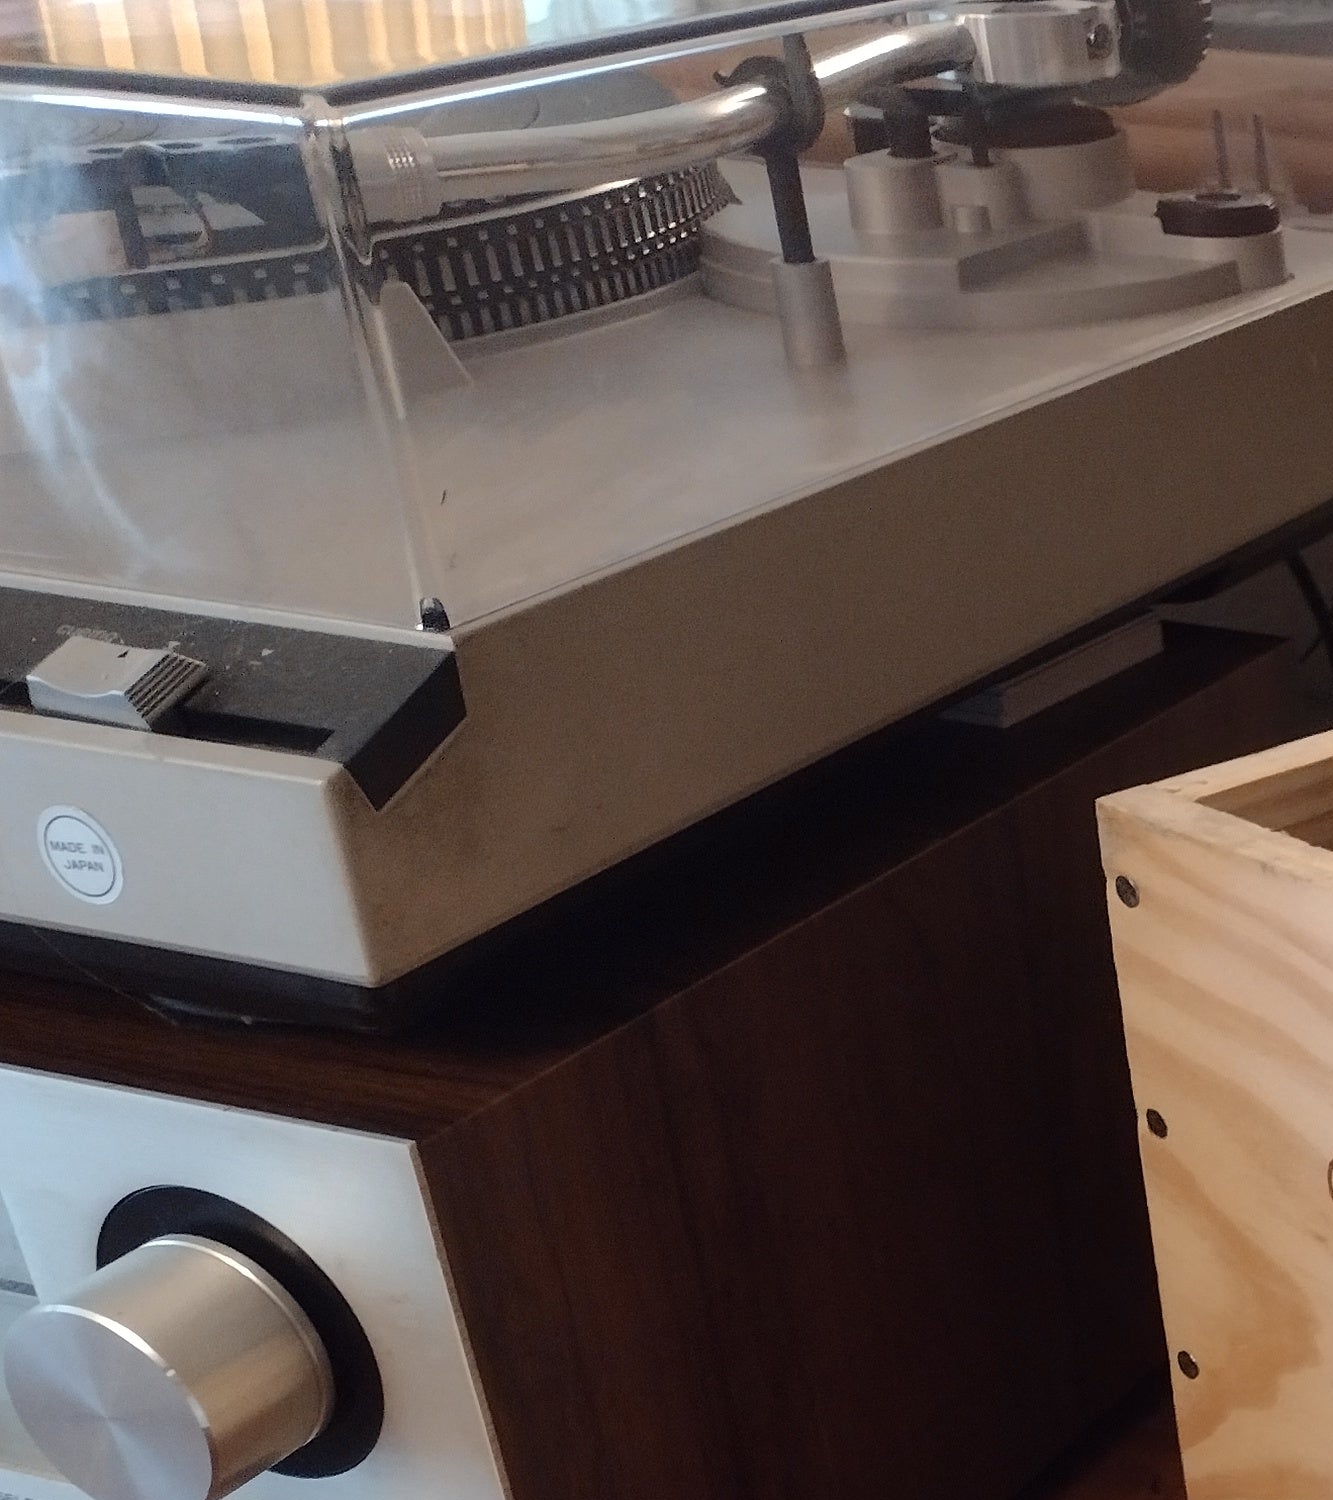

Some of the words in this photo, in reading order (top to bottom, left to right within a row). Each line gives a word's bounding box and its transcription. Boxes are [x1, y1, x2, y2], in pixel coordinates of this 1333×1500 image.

[50, 841, 87, 854] MADE
[91, 844, 104, 855] IN
[64, 860, 104, 872] JAPAN
